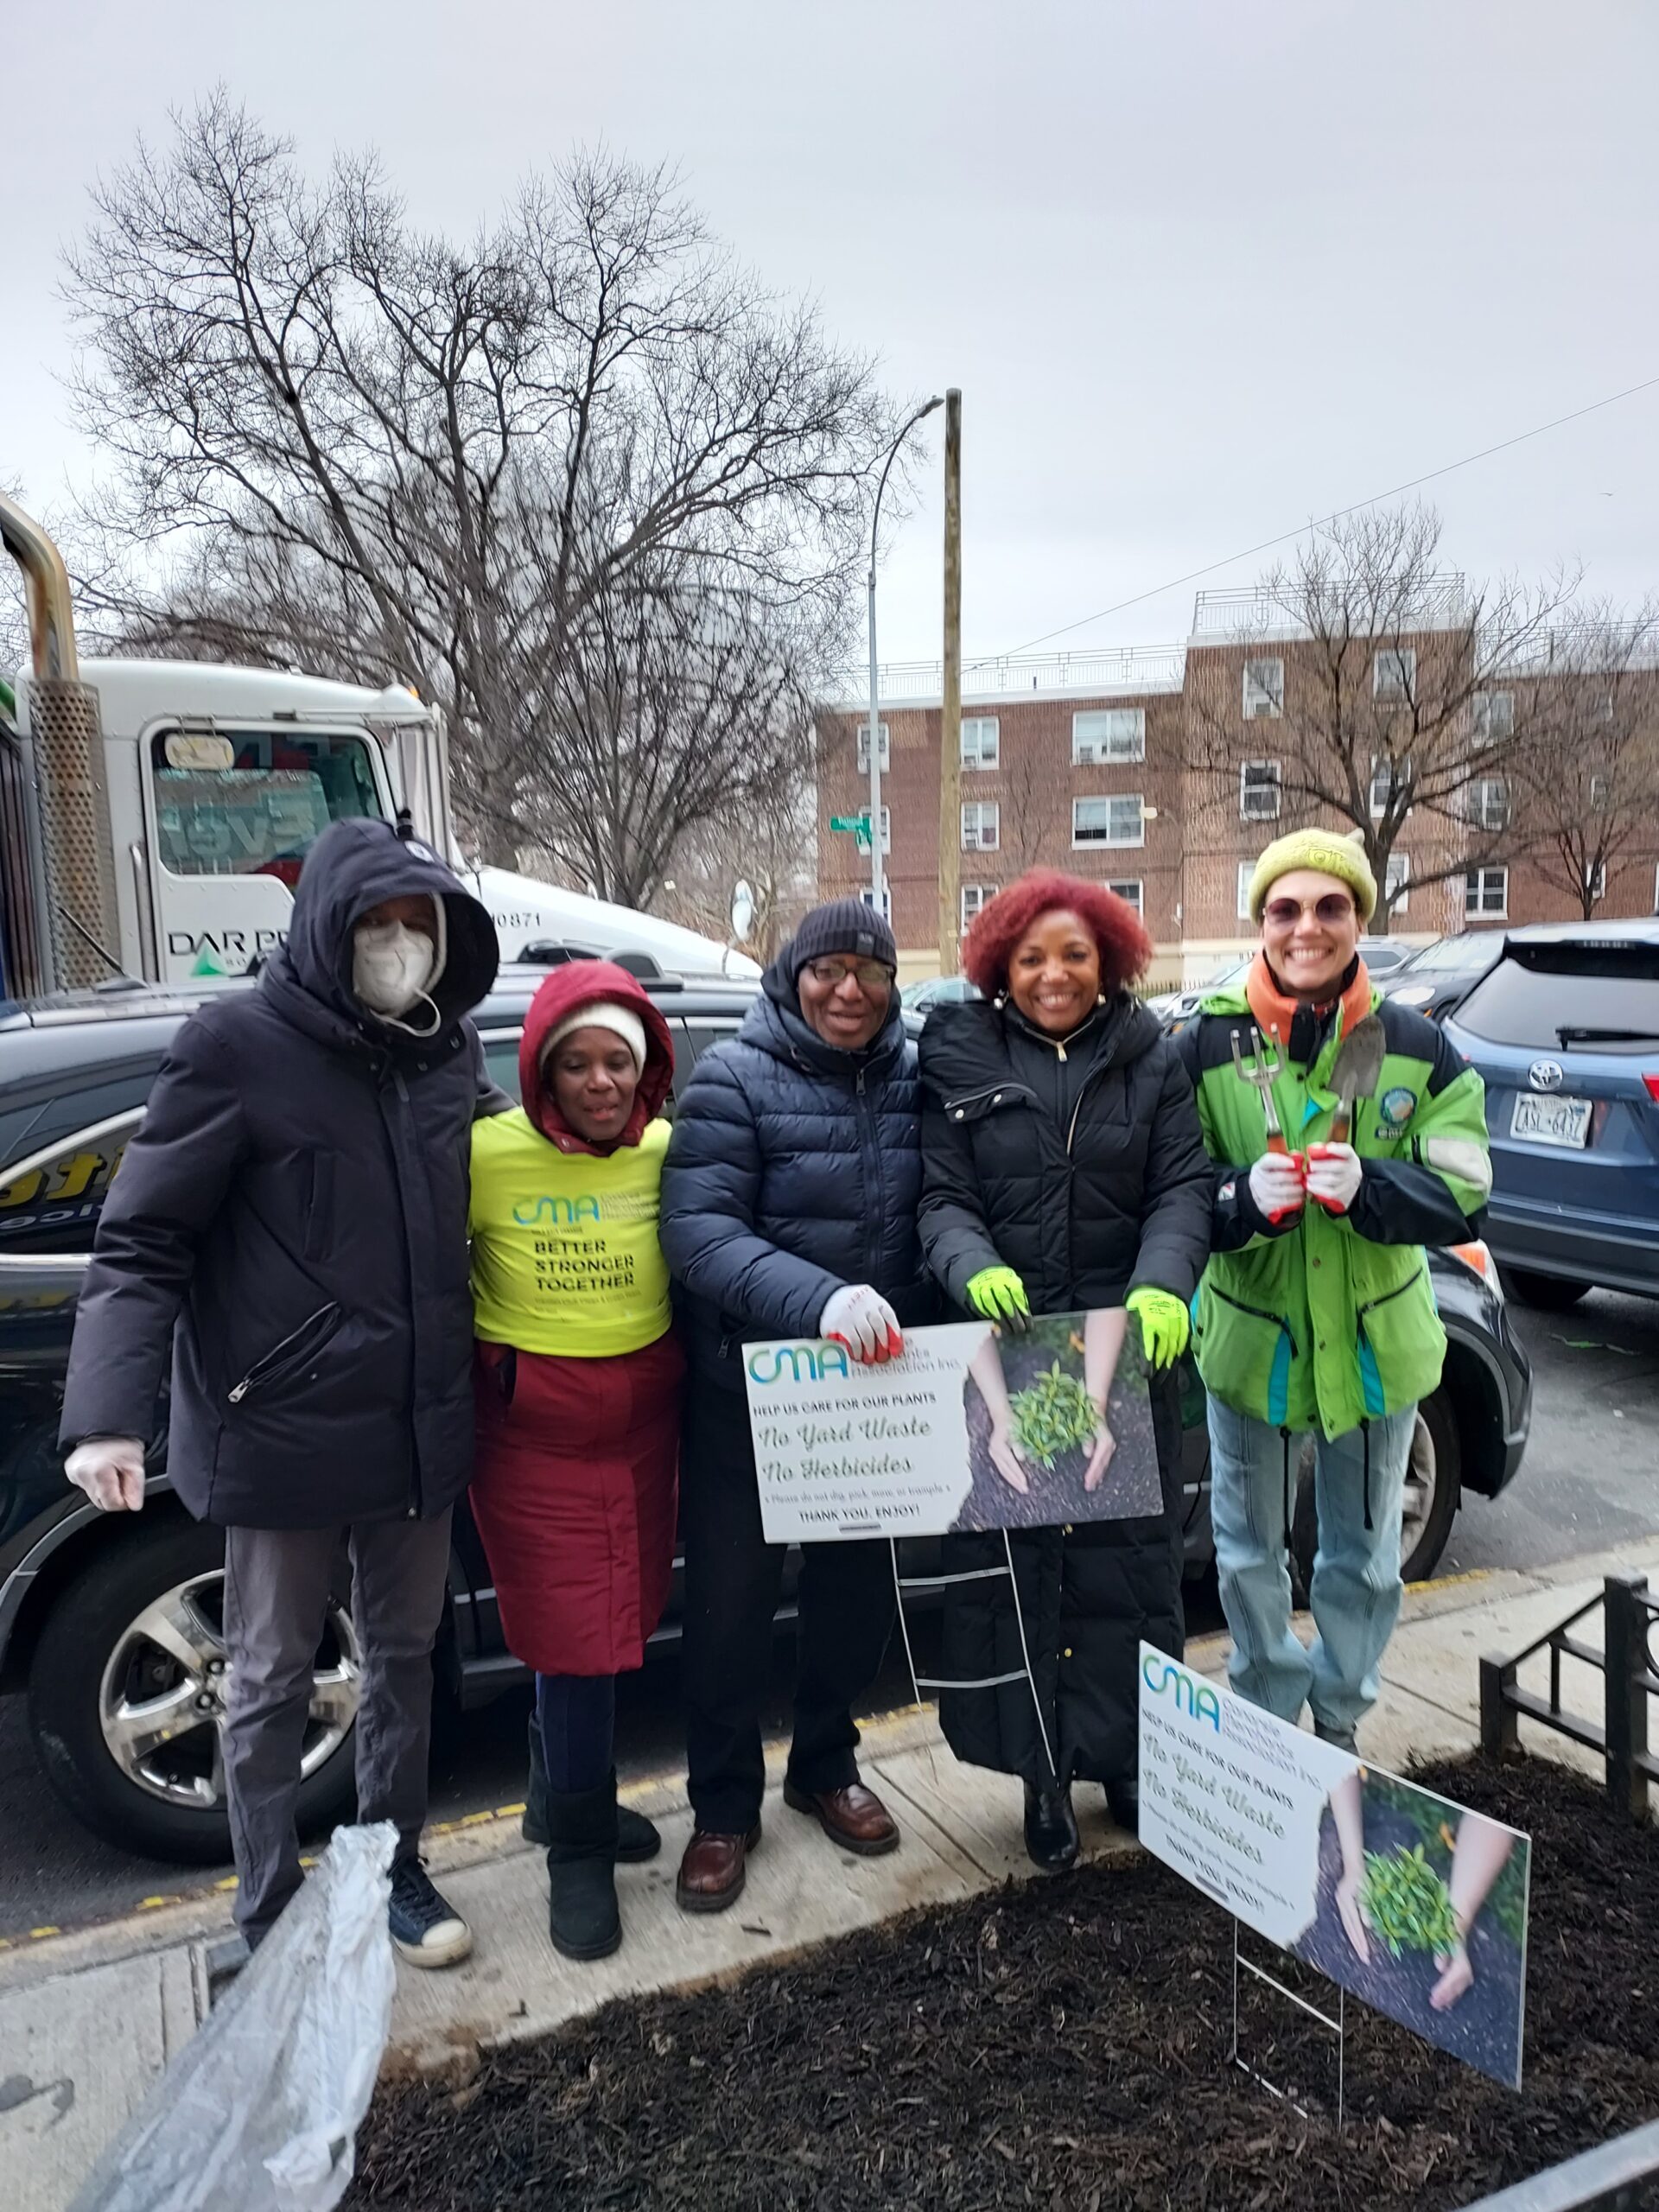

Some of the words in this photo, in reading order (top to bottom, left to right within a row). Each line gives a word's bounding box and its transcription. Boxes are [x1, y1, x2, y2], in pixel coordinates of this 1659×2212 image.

[168, 931, 246, 955] DAR
[512, 1195, 600, 1224] CMA
[535, 1239, 607, 1255] BETTER
[535, 1255, 634, 1274] STRONGER
[535, 1272, 634, 1292] TOGETHER
[748, 1344, 849, 1383] CMA
[753, 1404, 780, 1417] HELP
[784, 1402, 799, 1415] US
[802, 1398, 832, 1414] CARE
[836, 1396, 860, 1411] FOR
[862, 1394, 888, 1409] OUR
[892, 1391, 937, 1407] PLANTS
[758, 1426, 791, 1449] No
[797, 1420, 853, 1452] Yard
[859, 1415, 932, 1440] Waste
[762, 1460, 794, 1483] No
[800, 1452, 913, 1481] Herbicides
[798, 1510, 840, 1524] THANK
[875, 1503, 921, 1519] ENJOY!
[1142, 1654, 1221, 1735] CMA
[1143, 1732, 1167, 1764] No
[1172, 1752, 1217, 1798] Yard
[1222, 1784, 1287, 1841] Waste
[1142, 1768, 1167, 1800] No
[1171, 1786, 1264, 1866] Herbicides
